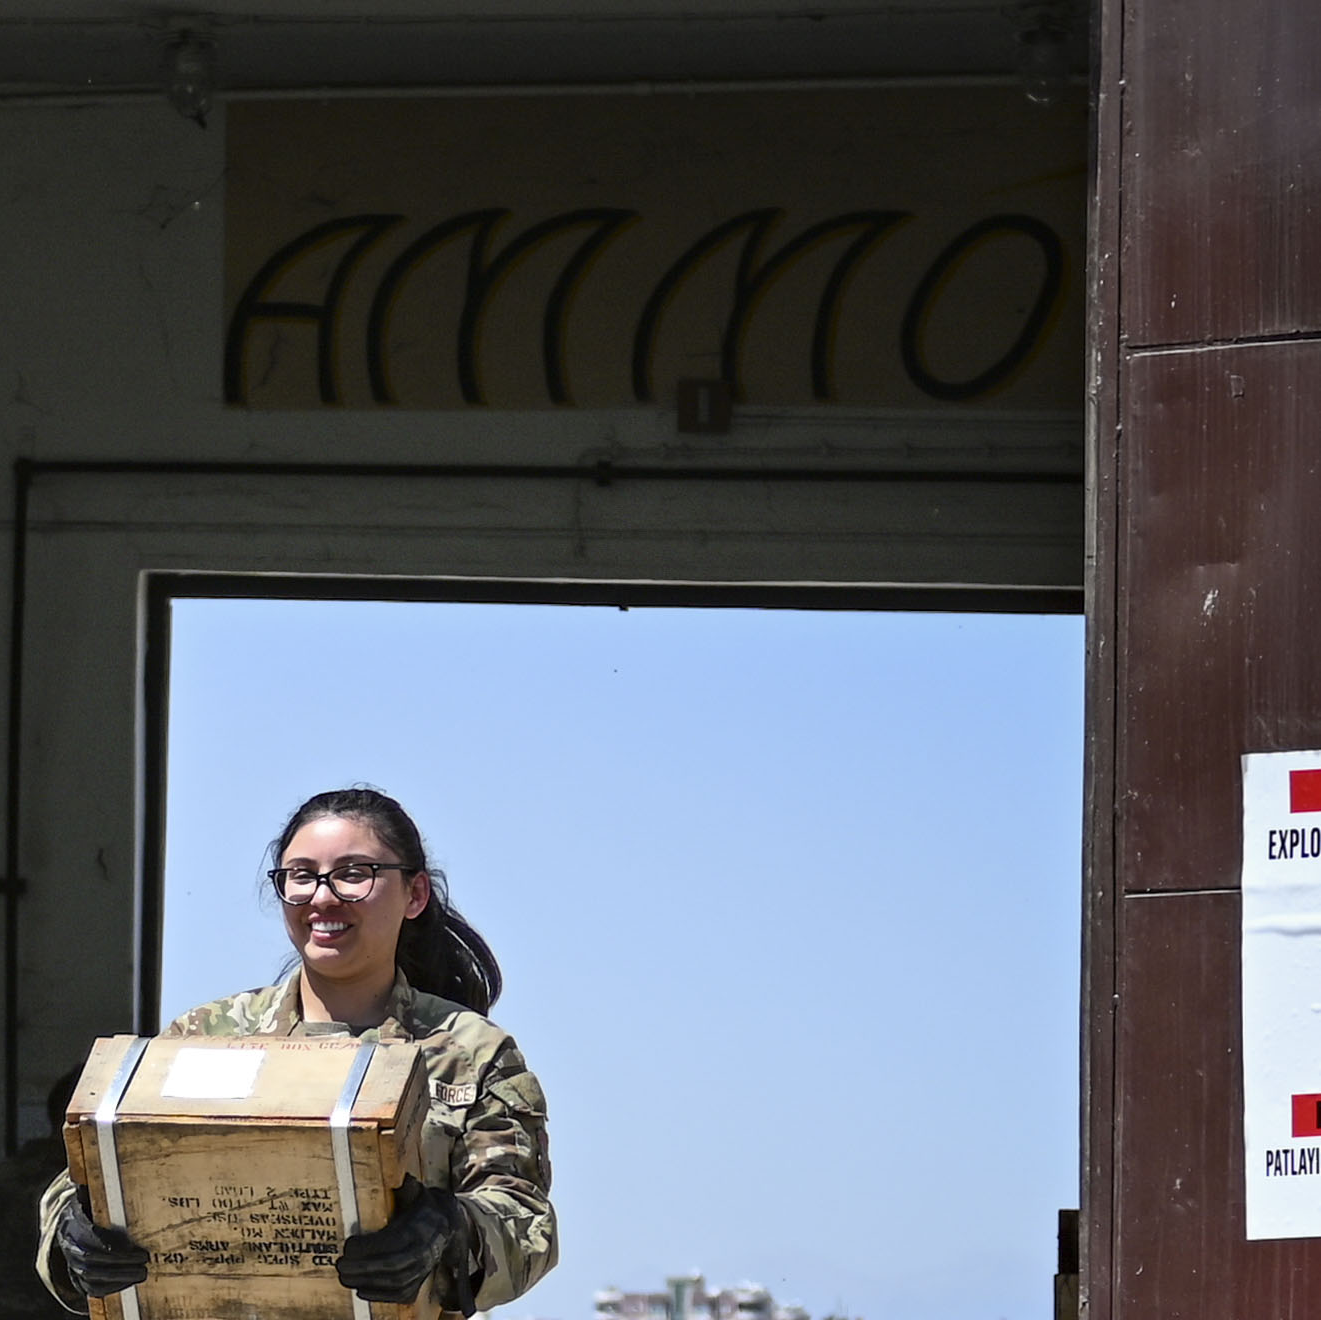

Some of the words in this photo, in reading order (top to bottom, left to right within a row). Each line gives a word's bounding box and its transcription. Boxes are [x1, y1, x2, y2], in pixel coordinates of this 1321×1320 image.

[223, 208, 1068, 405] AMMO
[1268, 827, 1321, 861] EXPLO
[435, 1080, 473, 1104] FORCE
[1265, 1147, 1321, 1178] PATLAYI
[265, 1186, 277, 1198] 2
[288, 1188, 331, 1200] TYPE
[162, 1197, 200, 1209] LBS.
[301, 1201, 333, 1213] MAX
[206, 1211, 238, 1225] USE
[249, 1213, 336, 1227] OVERSEAS
[233, 1226, 263, 1238] MO.
[274, 1228, 337, 1241] MALDEN
[188, 1240, 230, 1252] ARMS
[257, 1254, 301, 1266] SPEC
